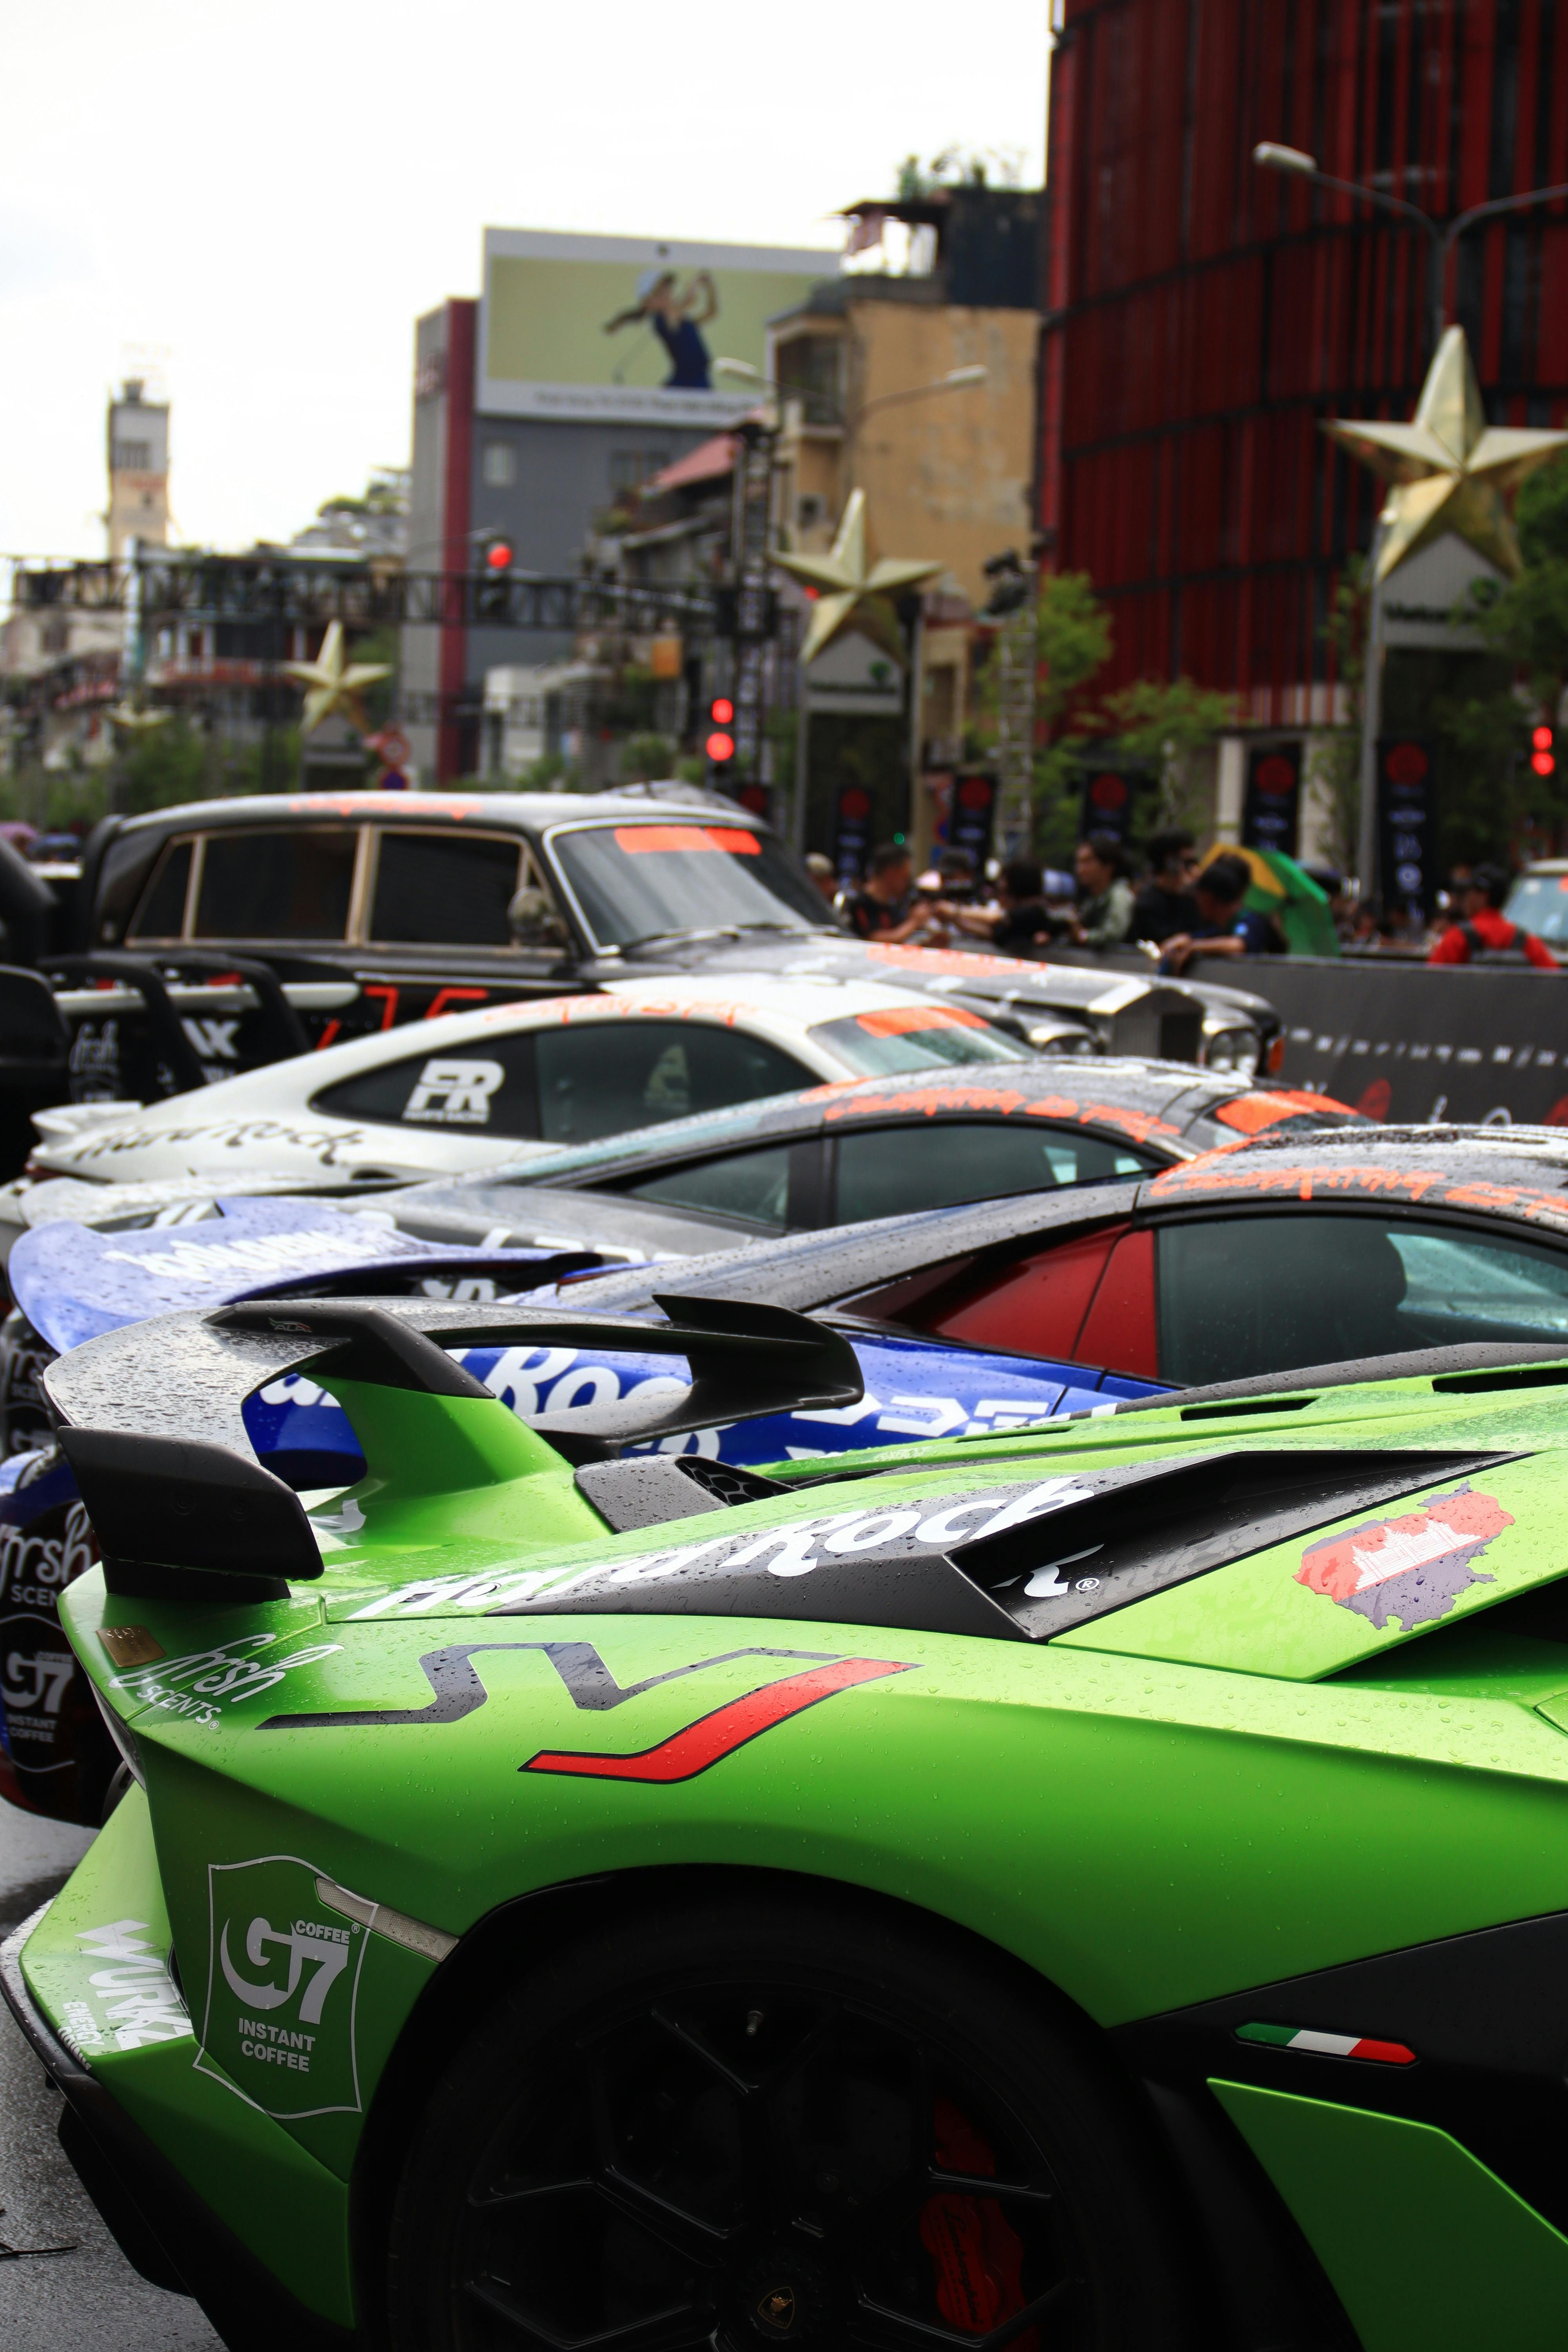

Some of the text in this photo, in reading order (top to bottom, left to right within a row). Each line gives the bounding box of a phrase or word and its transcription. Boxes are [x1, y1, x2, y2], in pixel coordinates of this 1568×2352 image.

[10, 1584, 58, 1606] SCEN
[136, 1684, 221, 1725] SCENTS
[295, 1920, 350, 1944] COFFEE
[220, 1917, 349, 2025] G7
[62, 2002, 105, 2045] ENERGY
[238, 2017, 316, 2052] INSTANT
[241, 2040, 310, 2073] COFFEE
